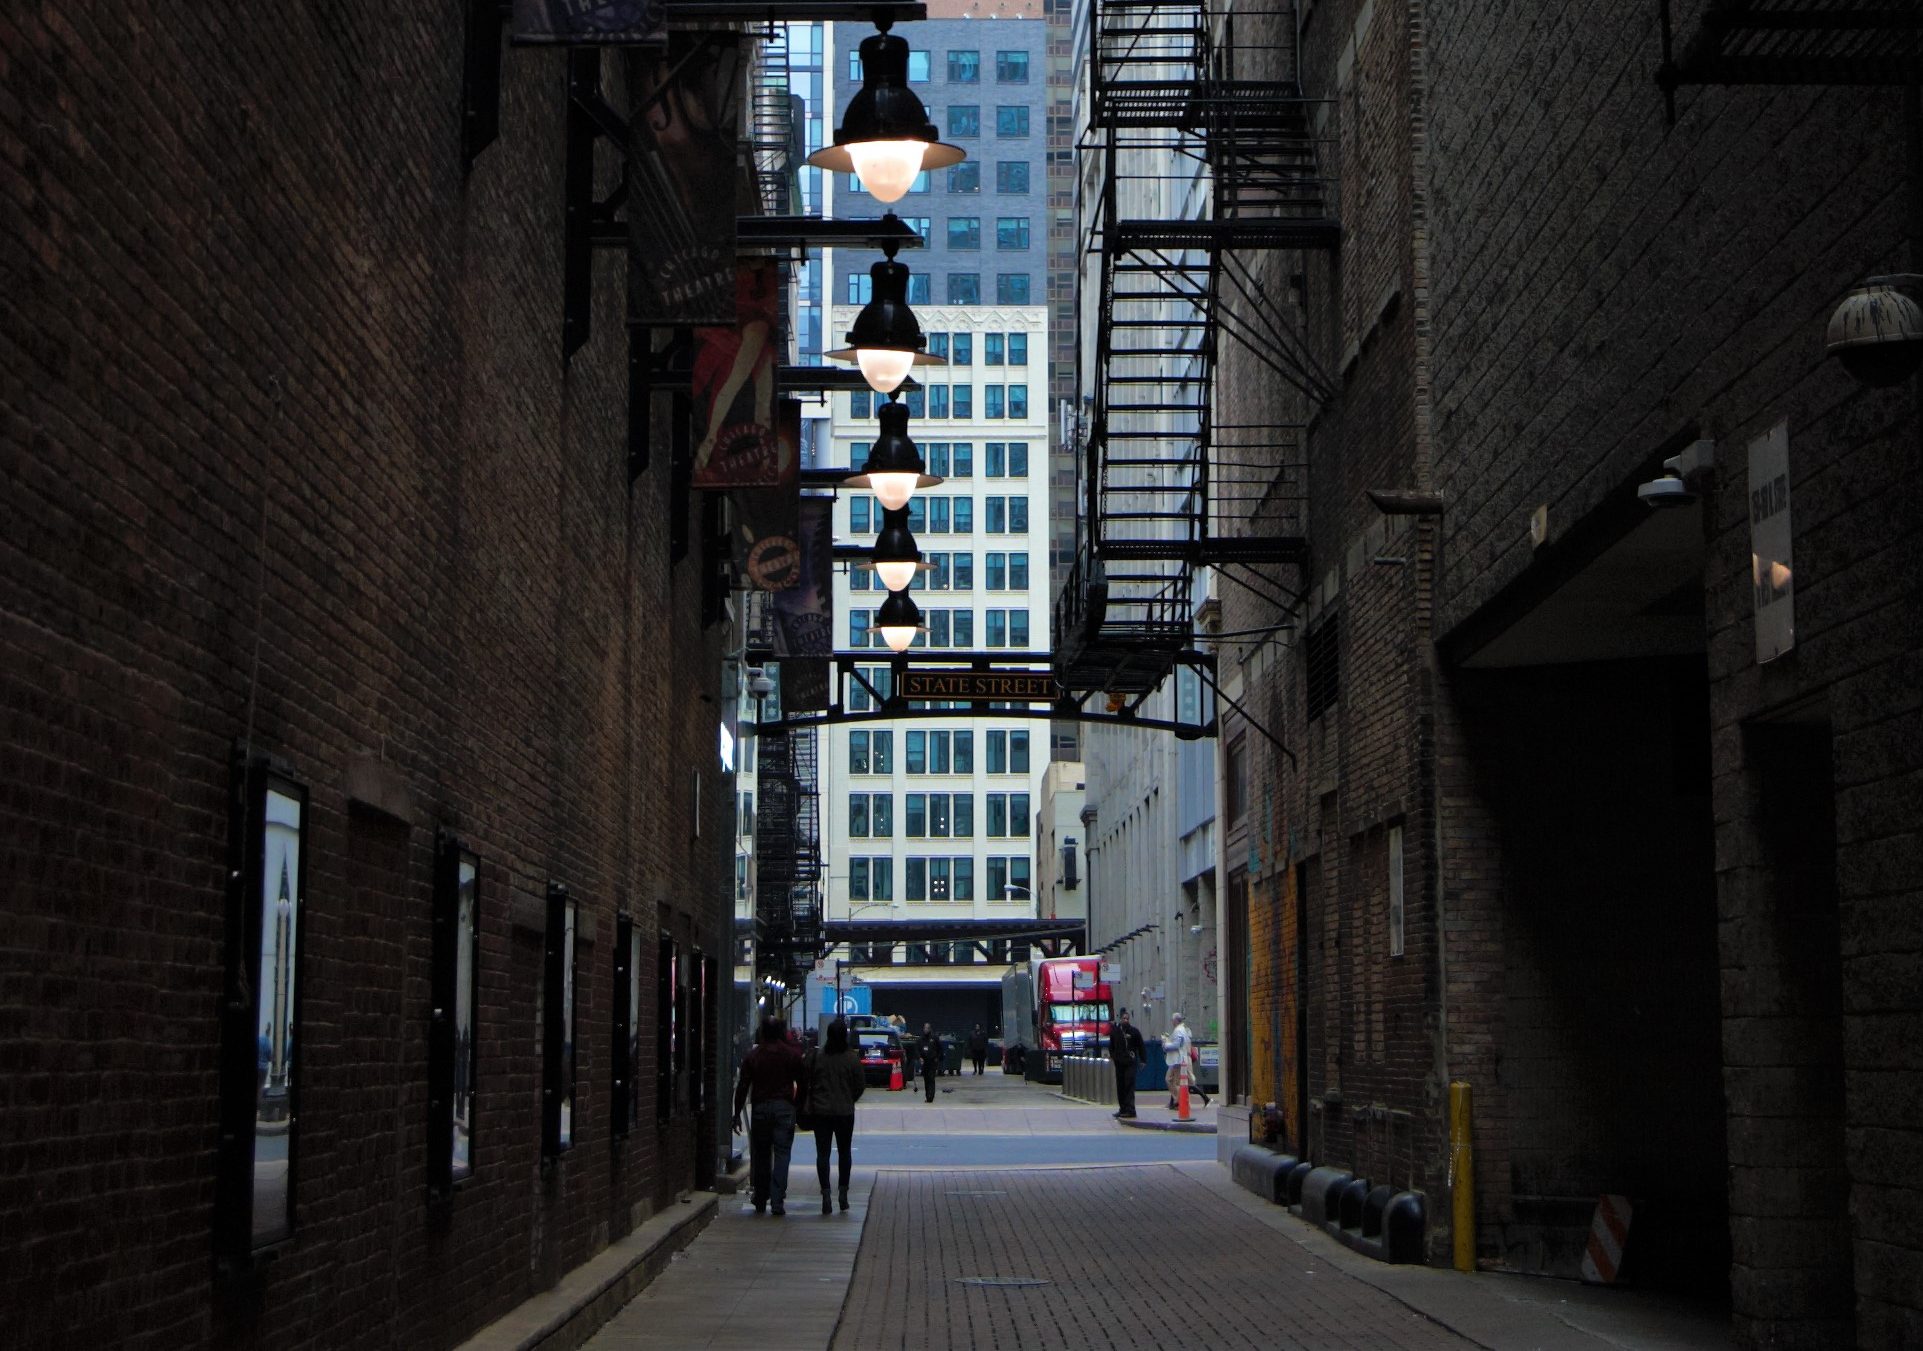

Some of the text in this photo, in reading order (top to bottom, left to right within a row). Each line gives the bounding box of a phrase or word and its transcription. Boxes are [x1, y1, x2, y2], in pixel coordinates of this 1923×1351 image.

[661, 266, 736, 307] THEATRE
[910, 677, 1050, 694] STATE STREET
